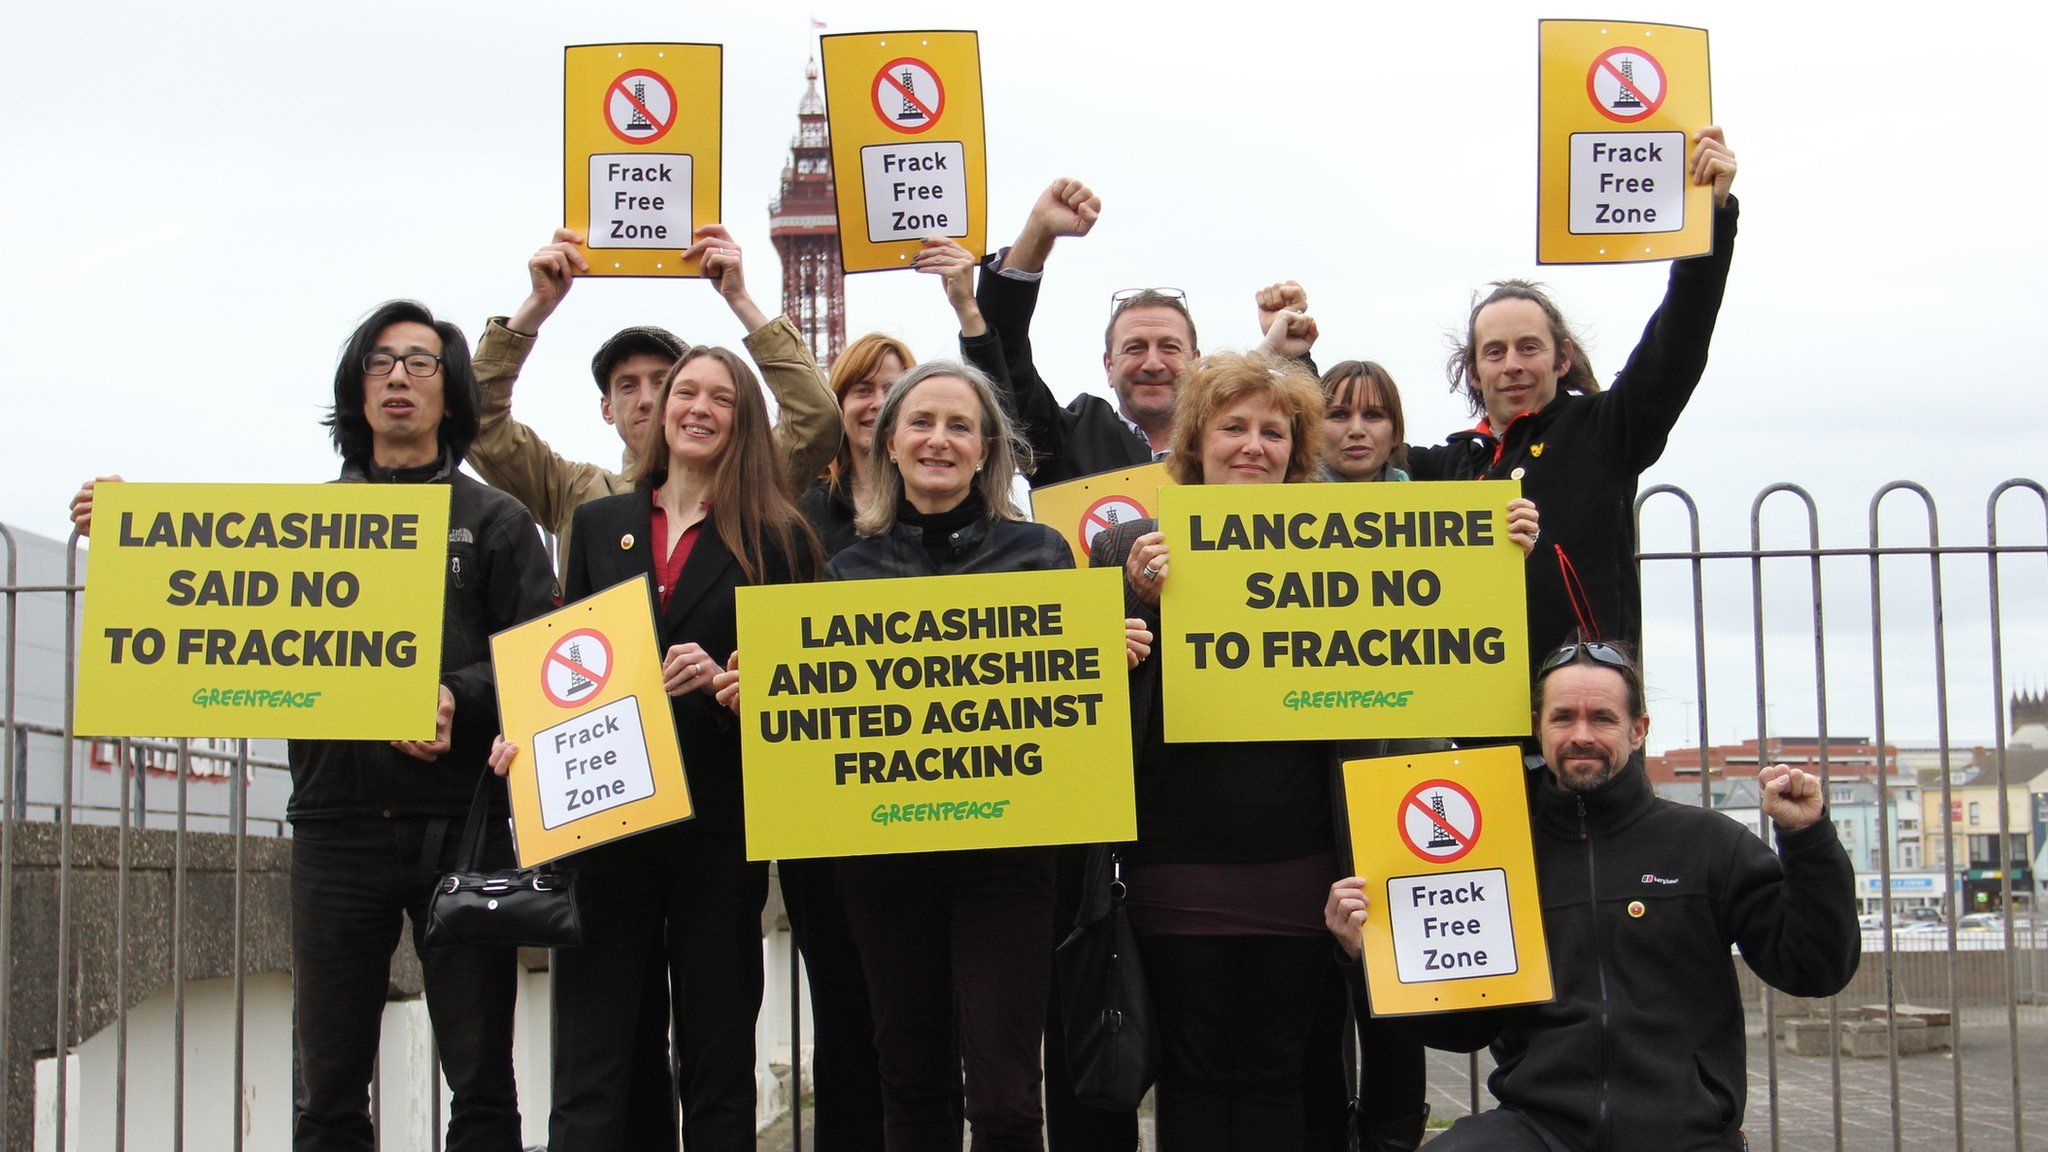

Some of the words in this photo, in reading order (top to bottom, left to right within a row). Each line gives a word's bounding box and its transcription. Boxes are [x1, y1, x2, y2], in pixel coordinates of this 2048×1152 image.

[884, 152, 946, 173] Frack
[1593, 143, 1662, 162] Frack
[609, 164, 672, 182] Frack
[1601, 174, 1654, 192] Free
[615, 192, 664, 210] Free
[893, 183, 942, 201] Free
[892, 212, 947, 231] Zone
[1596, 204, 1656, 223] Zone
[611, 220, 666, 239] Zone
[119, 512, 418, 549] LANCASHIRE
[1190, 511, 1493, 551] LANCASHIRE
[167, 570, 278, 606] SAID
[291, 571, 359, 608] NO
[1246, 572, 1359, 609] SAID
[1372, 570, 1441, 606] NO
[801, 604, 1062, 648] LANCASHIRE
[105, 628, 165, 664] TO
[178, 629, 417, 668] FRACKING
[1186, 632, 1249, 669] TO
[1263, 627, 1505, 668] FRACKING
[768, 661, 857, 696] AND
[866, 648, 1100, 690] YORKSHIRE
[192, 688, 320, 708] GREENPEACE
[1283, 690, 1414, 710] GREENPEACE
[760, 705, 911, 743] UNITED
[922, 694, 1103, 734] AGAINST
[554, 714, 620, 753] Frack
[565, 749, 617, 779] Free
[835, 743, 1042, 785] FRACKING
[565, 778, 626, 811] Zone
[872, 800, 1010, 825] GREENPEACE
[1412, 882, 1485, 907] Frack
[1424, 917, 1480, 938] Free
[1424, 950, 1487, 970] Zone
